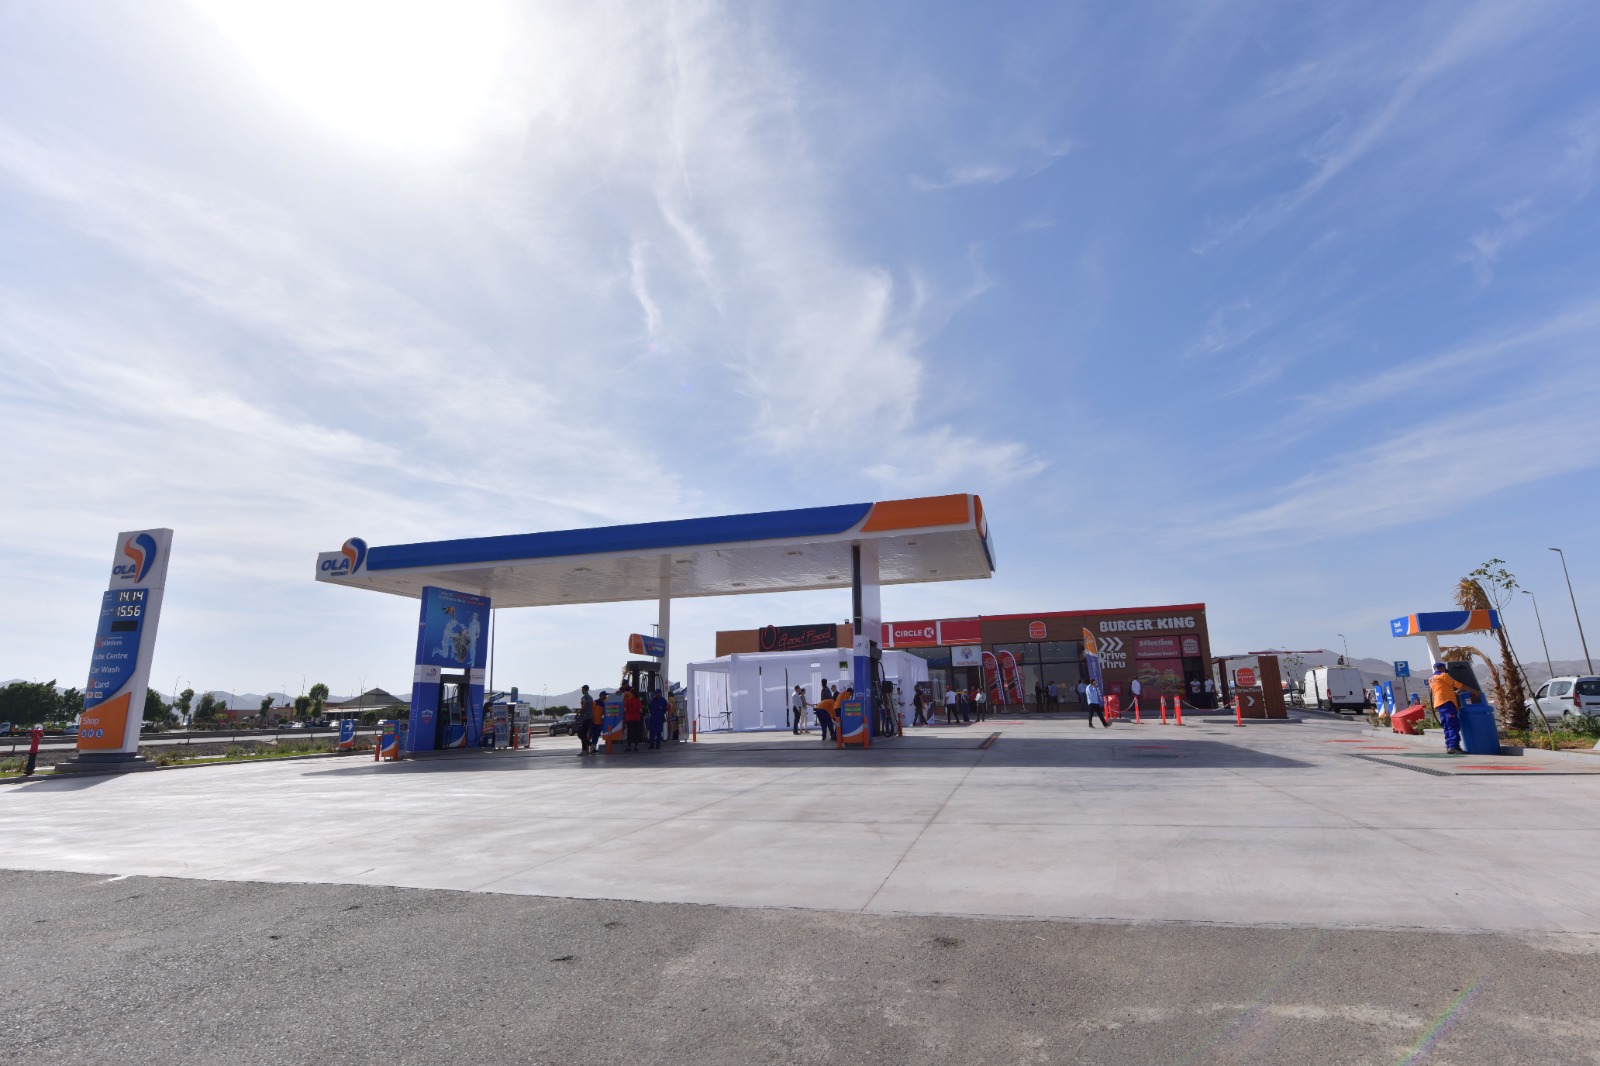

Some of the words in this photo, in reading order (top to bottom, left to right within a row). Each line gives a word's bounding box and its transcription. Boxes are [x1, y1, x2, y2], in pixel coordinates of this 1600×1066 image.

[113, 564, 136, 575] OLA
[321, 558, 349, 571] OLA
[119, 591, 143, 601] 14.14
[117, 605, 140, 616] 15.56
[1100, 620, 1153, 632] BURGER
[1157, 617, 1195, 629] KING
[806, 625, 832, 641] Food
[894, 629, 922, 637] CIRCLE
[924, 627, 934, 638] K
[1138, 639, 1173, 647] Sélection
[1099, 651, 1126, 660] Drive
[101, 665, 120, 673] Wash
[1100, 660, 1126, 669] Thru
[1397, 662, 1406, 672] P
[83, 717, 99, 726] Shop
